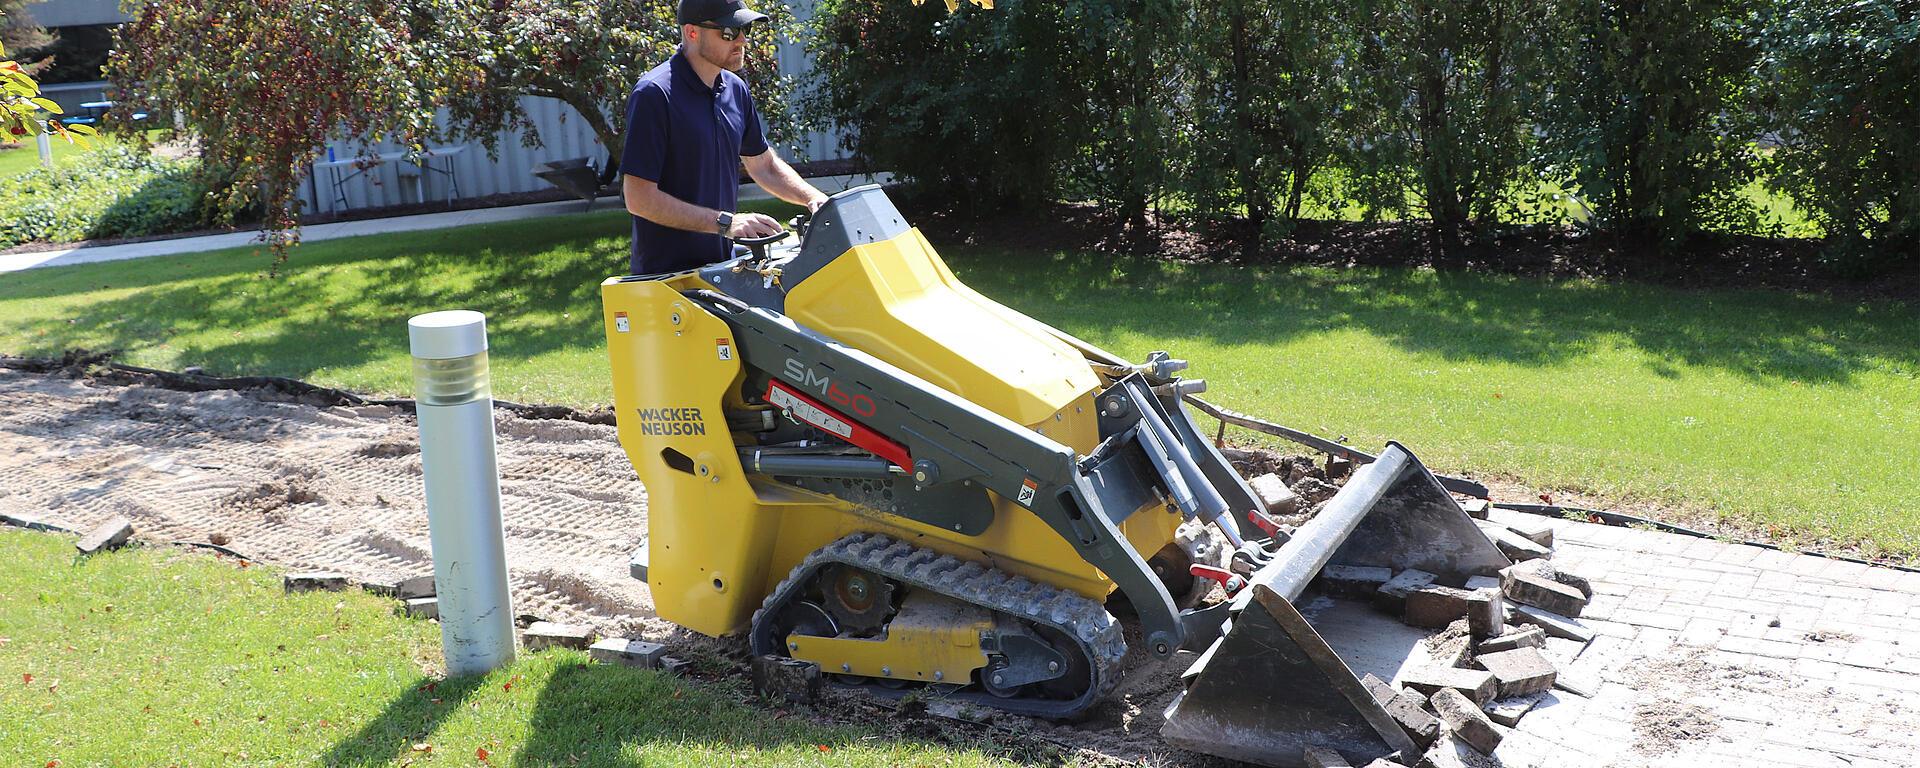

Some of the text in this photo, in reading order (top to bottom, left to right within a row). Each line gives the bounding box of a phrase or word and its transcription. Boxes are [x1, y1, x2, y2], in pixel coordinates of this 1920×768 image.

[784, 358, 876, 417] SM60
[637, 408, 703, 421] WACKER
[641, 422, 706, 435] NEUSON
